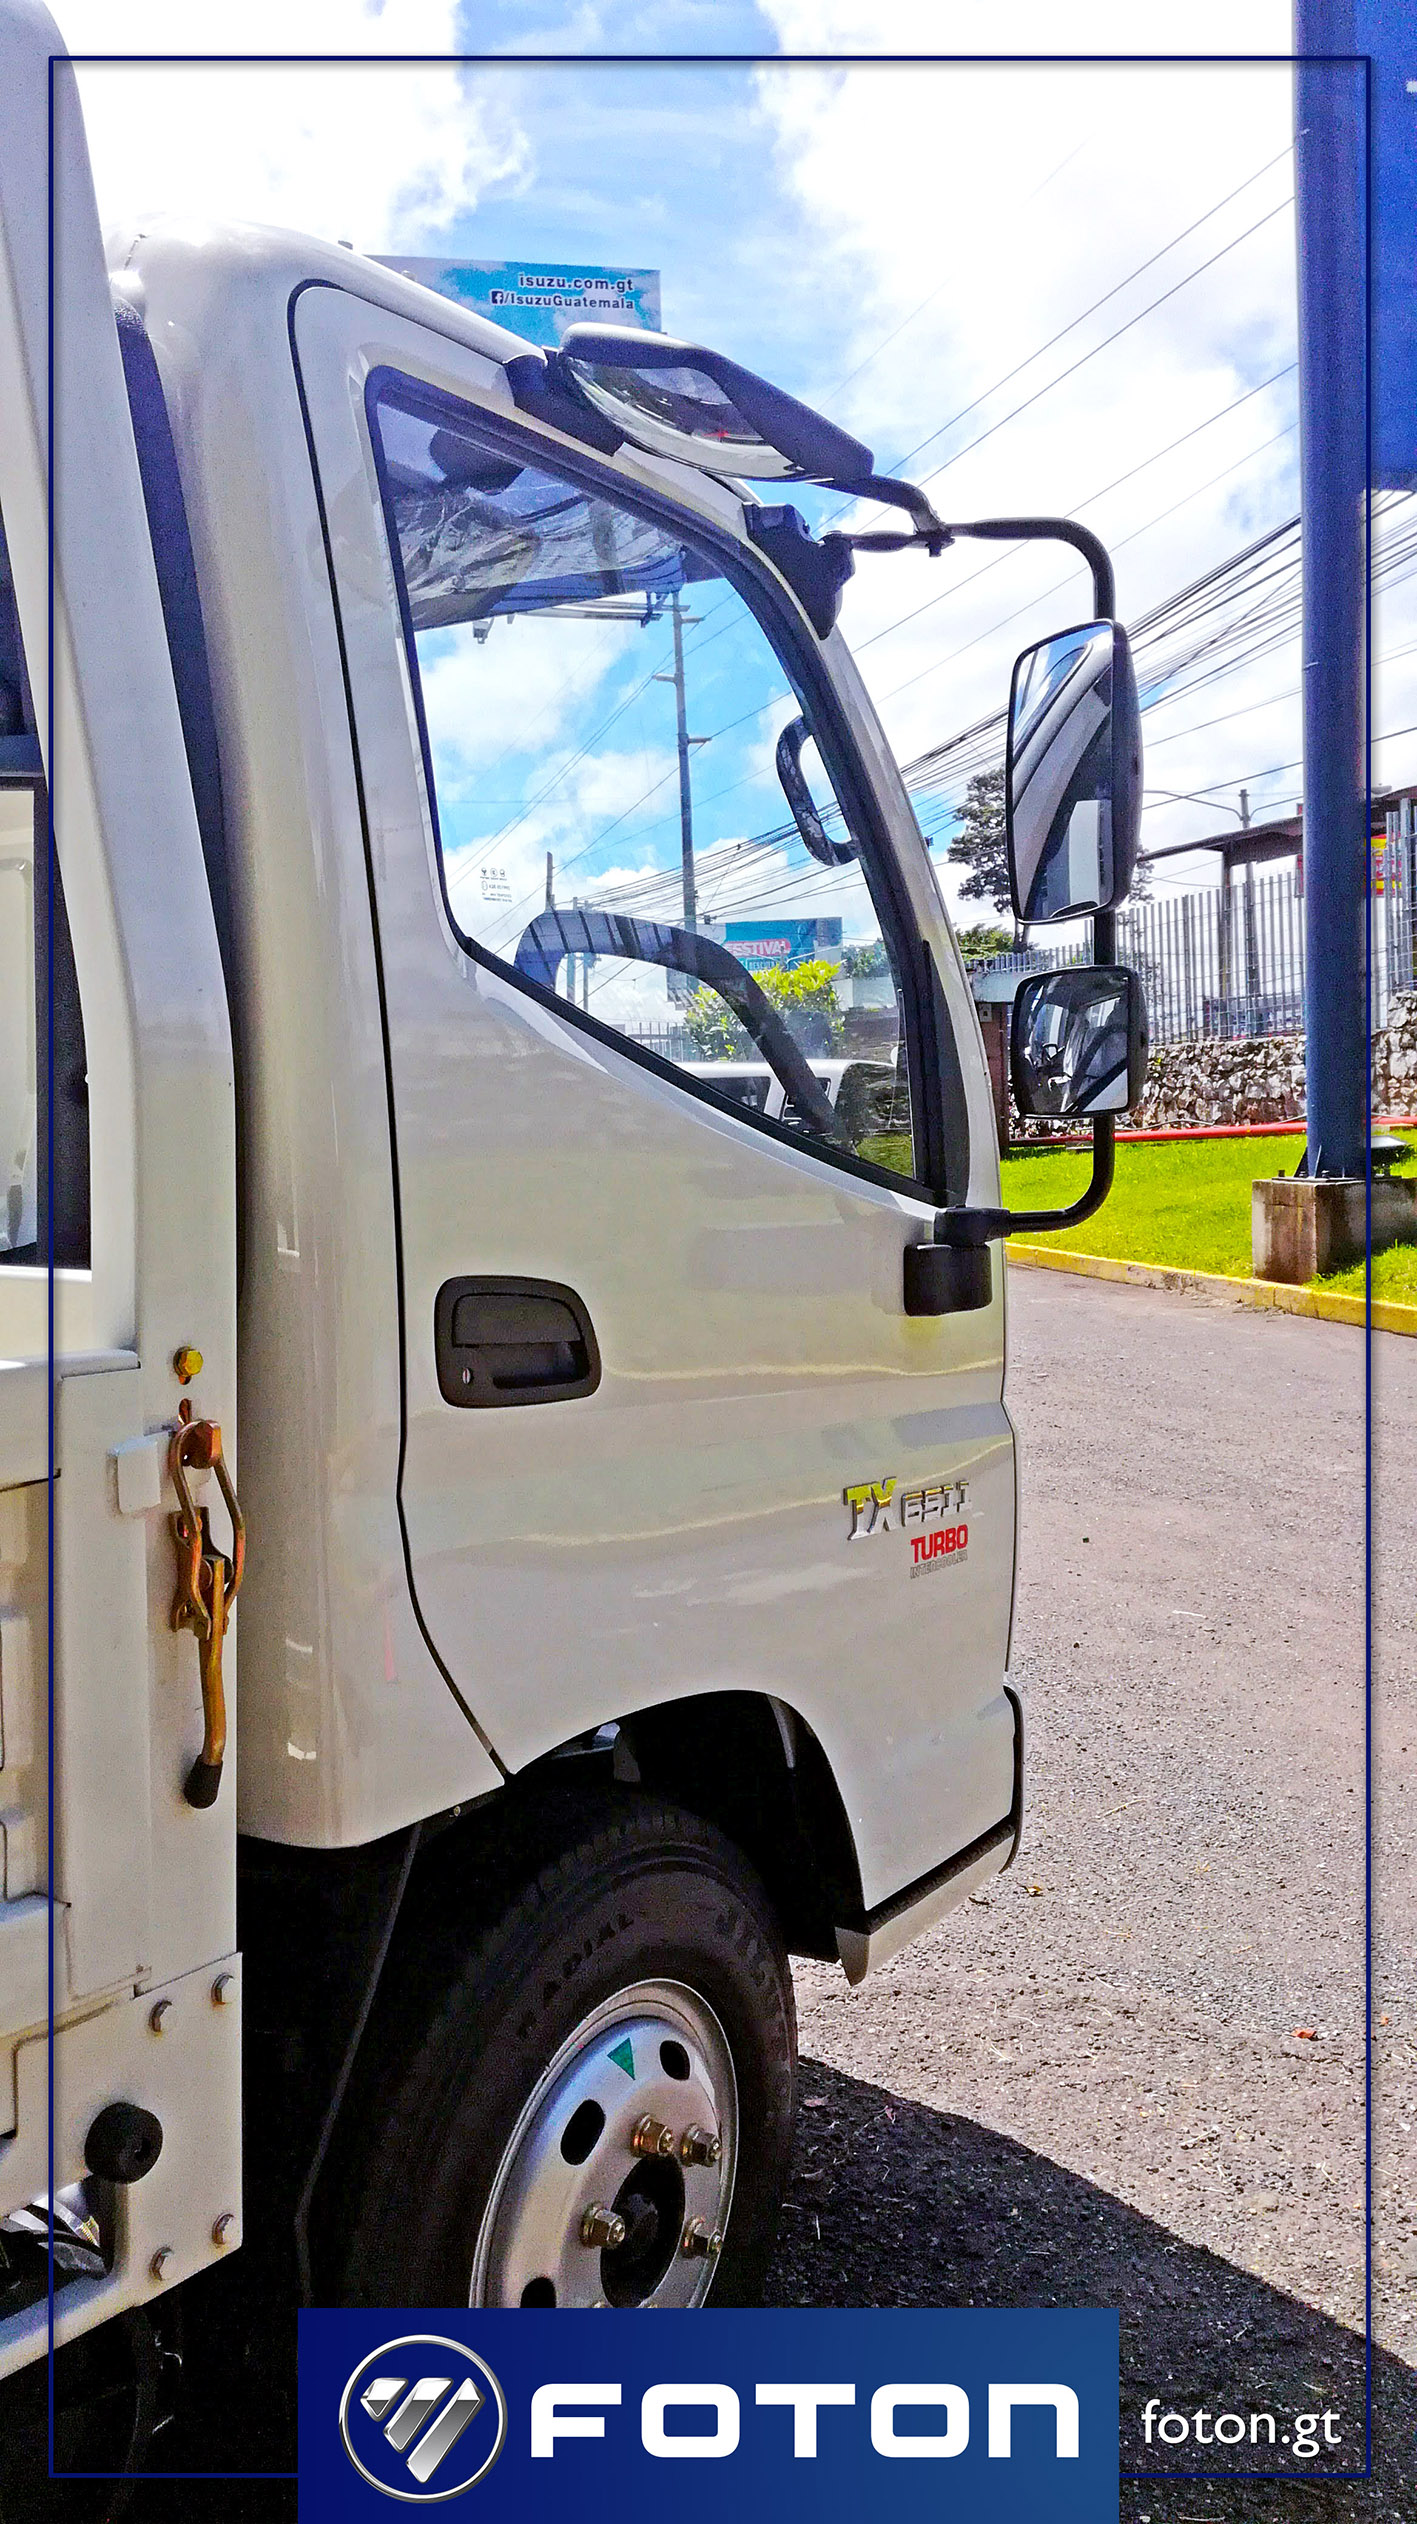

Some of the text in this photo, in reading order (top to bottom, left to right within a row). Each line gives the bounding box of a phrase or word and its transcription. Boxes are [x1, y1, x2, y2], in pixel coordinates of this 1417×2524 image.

[519, 274, 634, 292] isuzu.com.gt
[843, 1476, 898, 1541] TX
[911, 1524, 969, 1563] TURBO
